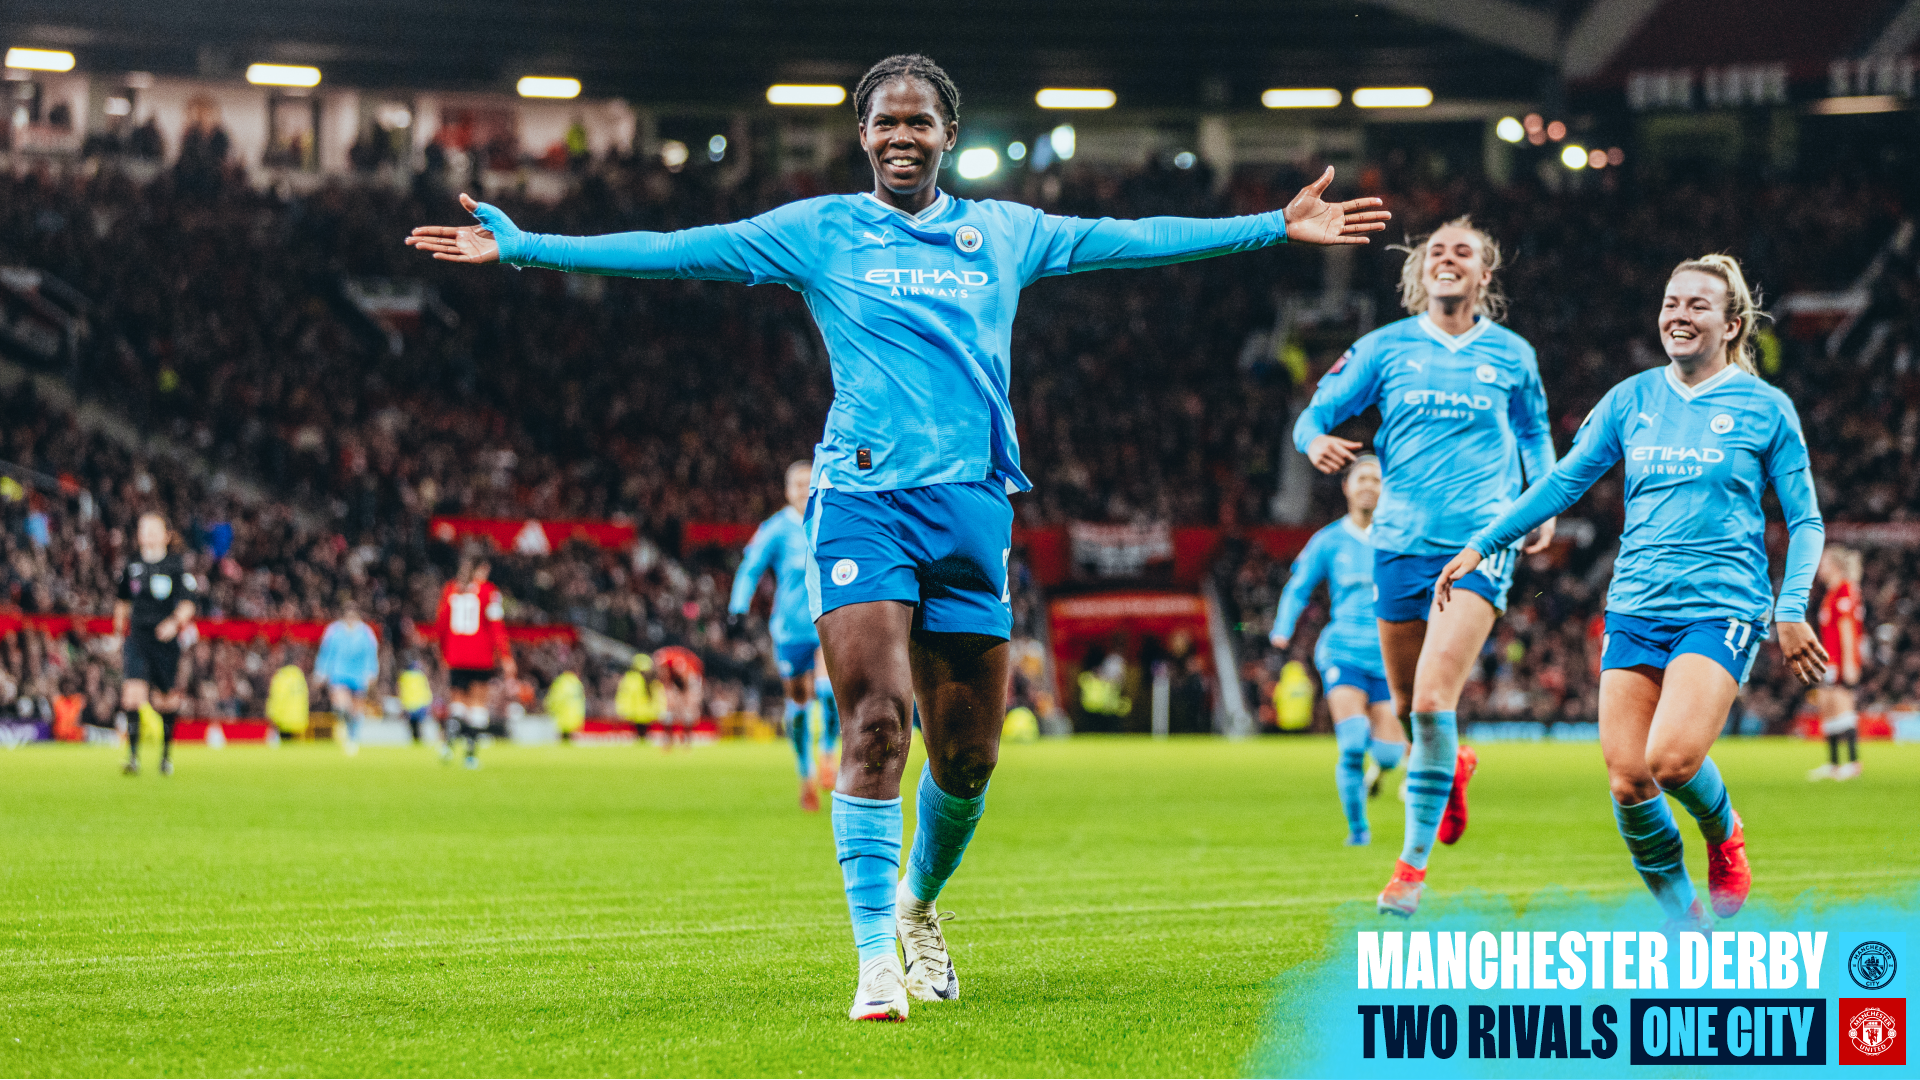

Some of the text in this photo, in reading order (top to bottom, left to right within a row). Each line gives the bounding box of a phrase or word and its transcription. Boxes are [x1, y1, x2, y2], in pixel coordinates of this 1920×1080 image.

[864, 268, 989, 287] ETIHAD
[890, 285, 969, 299] AIRWAYS
[1403, 389, 1493, 411] ETIHAD
[1631, 445, 1725, 463] ETIHAD
[1642, 464, 1703, 476] AIRWAYS
[1724, 615, 1752, 649] 11
